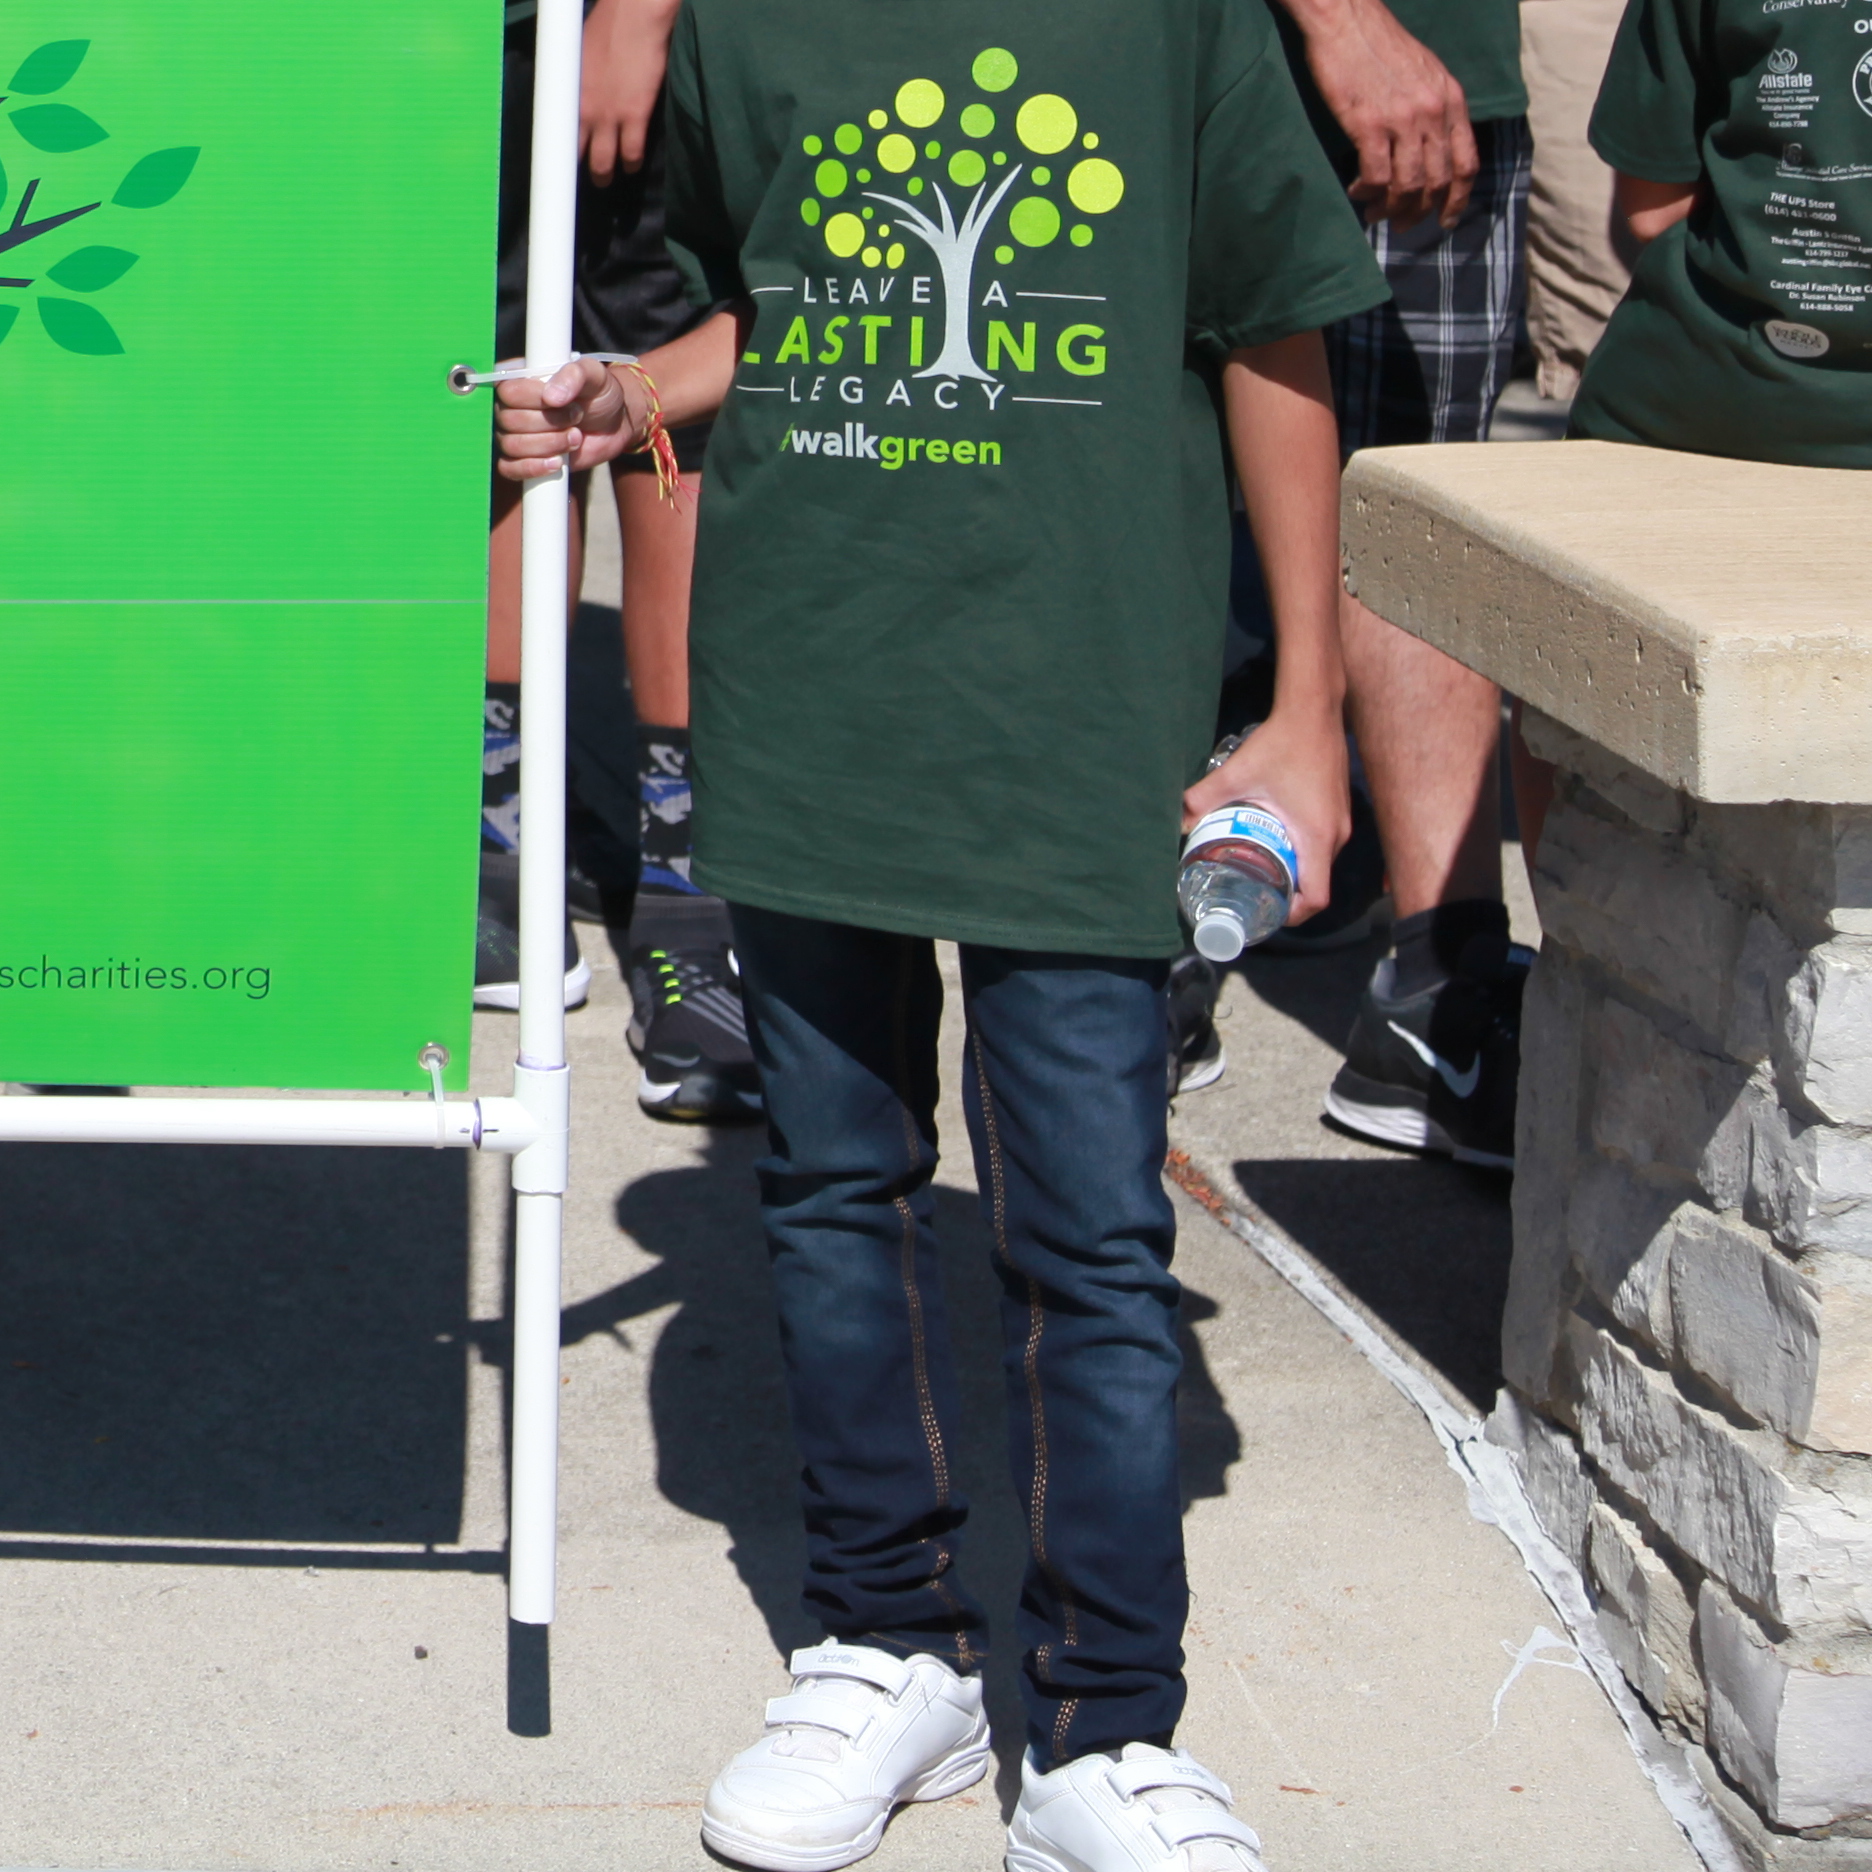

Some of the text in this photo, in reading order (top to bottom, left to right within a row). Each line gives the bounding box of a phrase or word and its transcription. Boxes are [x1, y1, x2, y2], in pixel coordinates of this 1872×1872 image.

[1758, 73, 1813, 88] Allstate
[1808, 199, 1835, 210] Store
[803, 276, 1009, 308] LEAVE A
[1770, 280, 1810, 291] Cardinal
[1811, 283, 1844, 295] Family
[789, 376, 1006, 411] LEGACY
